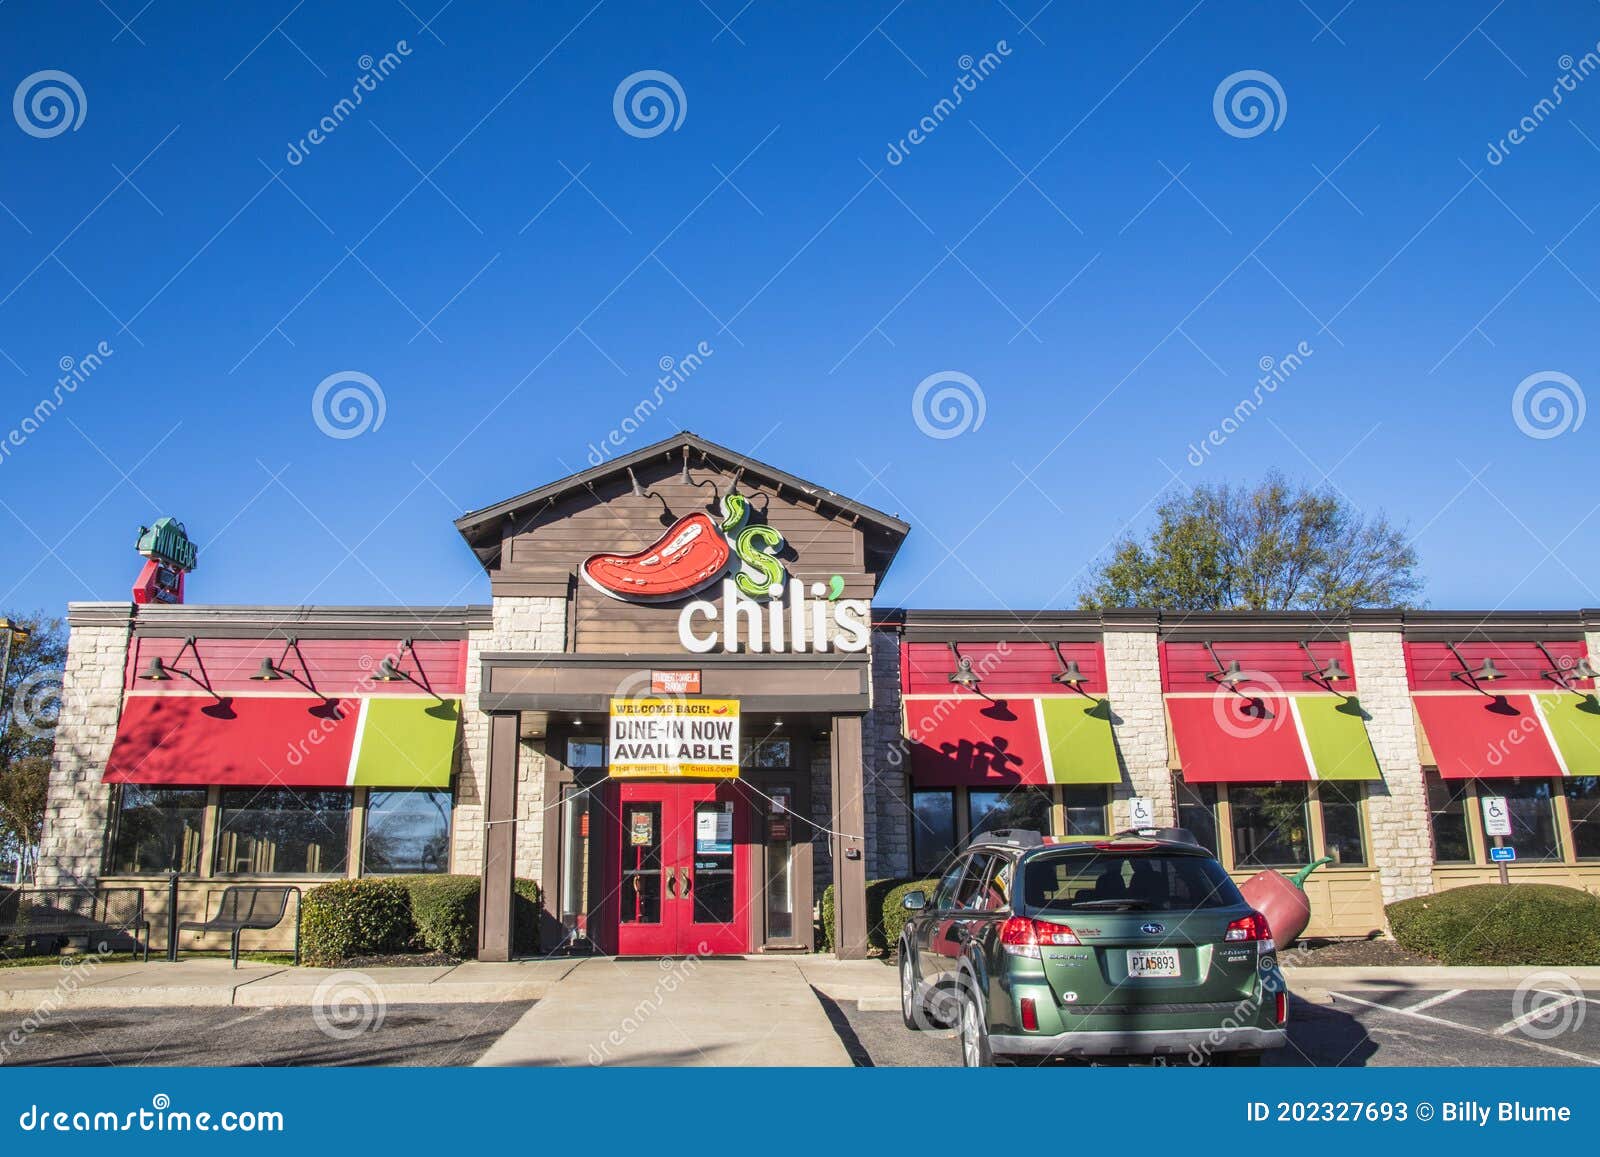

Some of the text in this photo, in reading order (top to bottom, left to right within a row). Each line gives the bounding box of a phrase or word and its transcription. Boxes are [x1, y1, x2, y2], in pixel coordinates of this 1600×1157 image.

[678, 575, 869, 653] chili's
[616, 705, 710, 714] WELCOME BACK!
[615, 721, 733, 740] DINE-IN NOW
[614, 743, 733, 760] AVAILABLE
